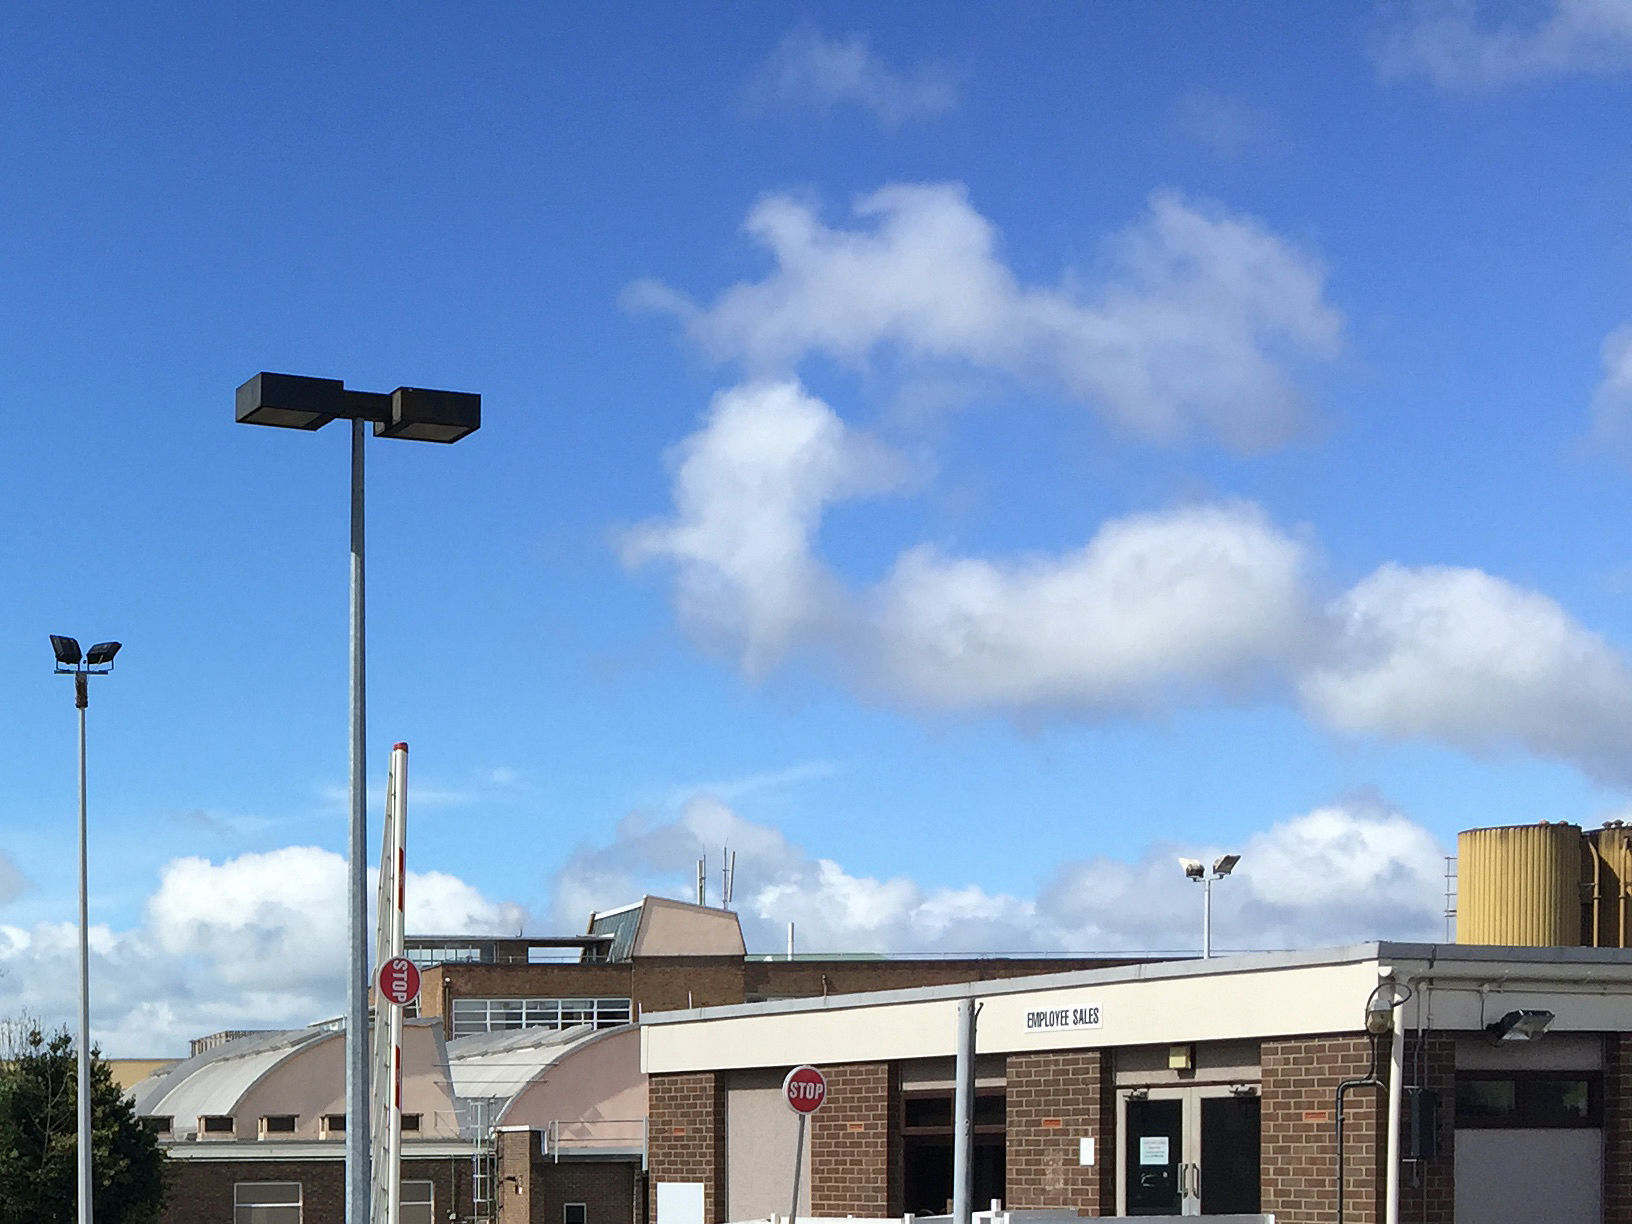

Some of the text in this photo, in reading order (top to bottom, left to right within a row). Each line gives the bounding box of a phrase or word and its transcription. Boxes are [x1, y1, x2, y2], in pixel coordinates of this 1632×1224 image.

[392, 960, 408, 1002] STOP
[1027, 1007, 1099, 1028] EMPLOYEE SALES
[789, 1081, 823, 1099] STOP
